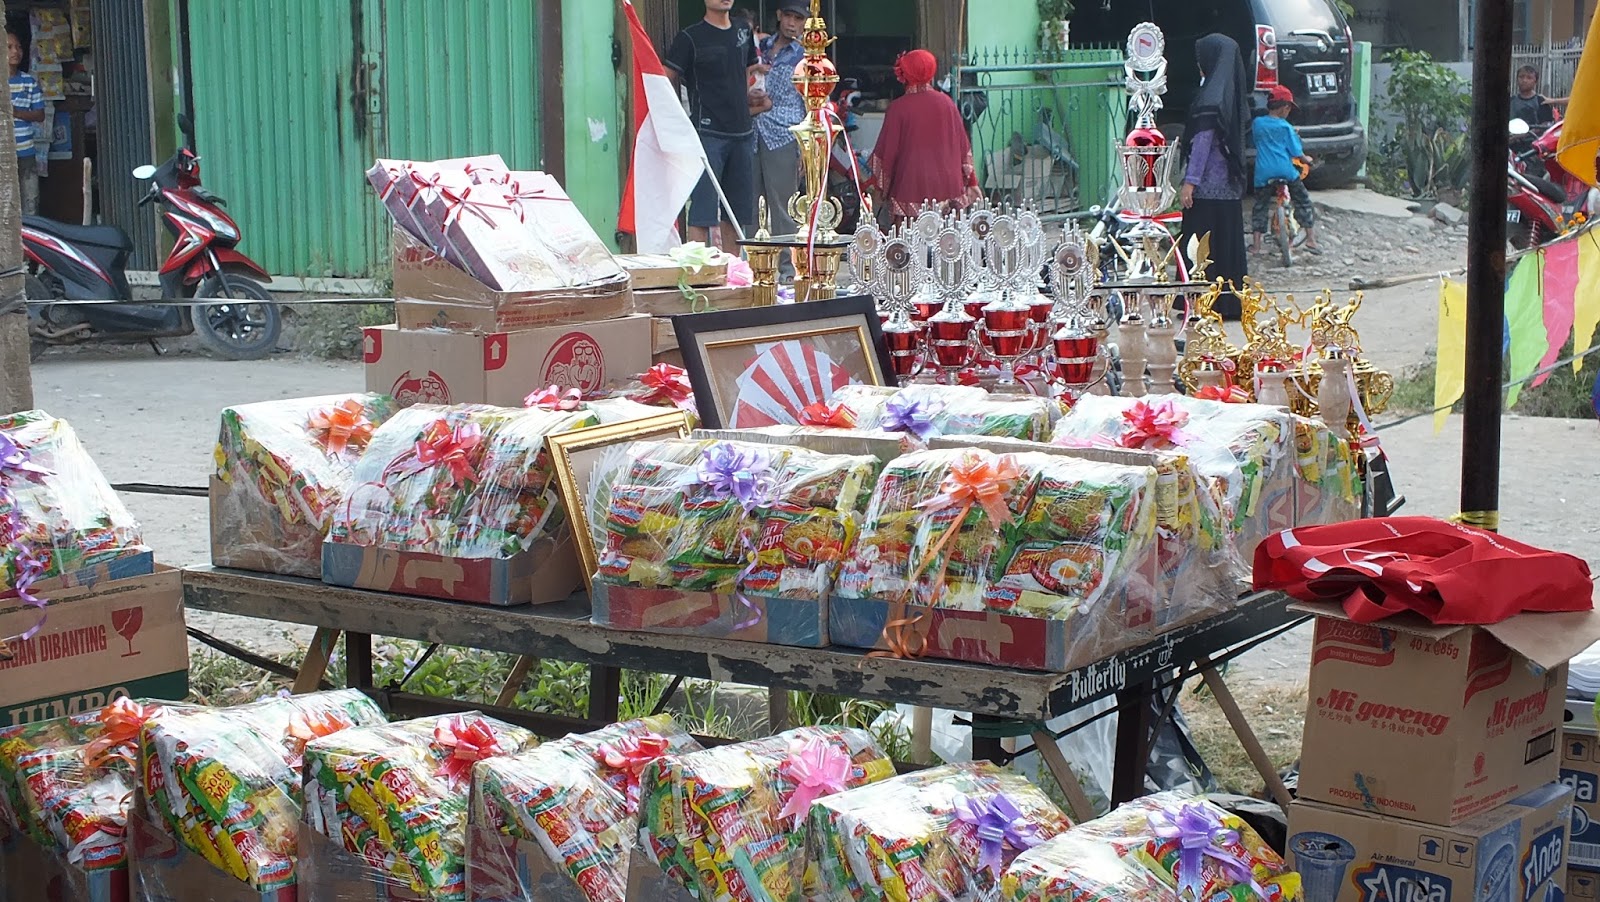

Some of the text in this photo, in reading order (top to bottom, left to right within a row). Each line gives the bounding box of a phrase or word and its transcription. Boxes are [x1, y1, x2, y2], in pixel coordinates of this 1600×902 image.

[40, 624, 107, 662] DIBANTING
[1329, 650, 1377, 664] Instant Noodles
[1409, 637, 1422, 650] 40
[1071, 655, 1126, 703] Butterfly
[1316, 688, 1450, 735] Mi goreng
[1486, 697, 1509, 728] Mi
[1506, 688, 1548, 729] goreng
[1329, 787, 1363, 801] PRODUCT
[1376, 796, 1417, 812] INDONESIA
[1371, 852, 1416, 867] Air Mineral
[1364, 868, 1447, 902] Anda
